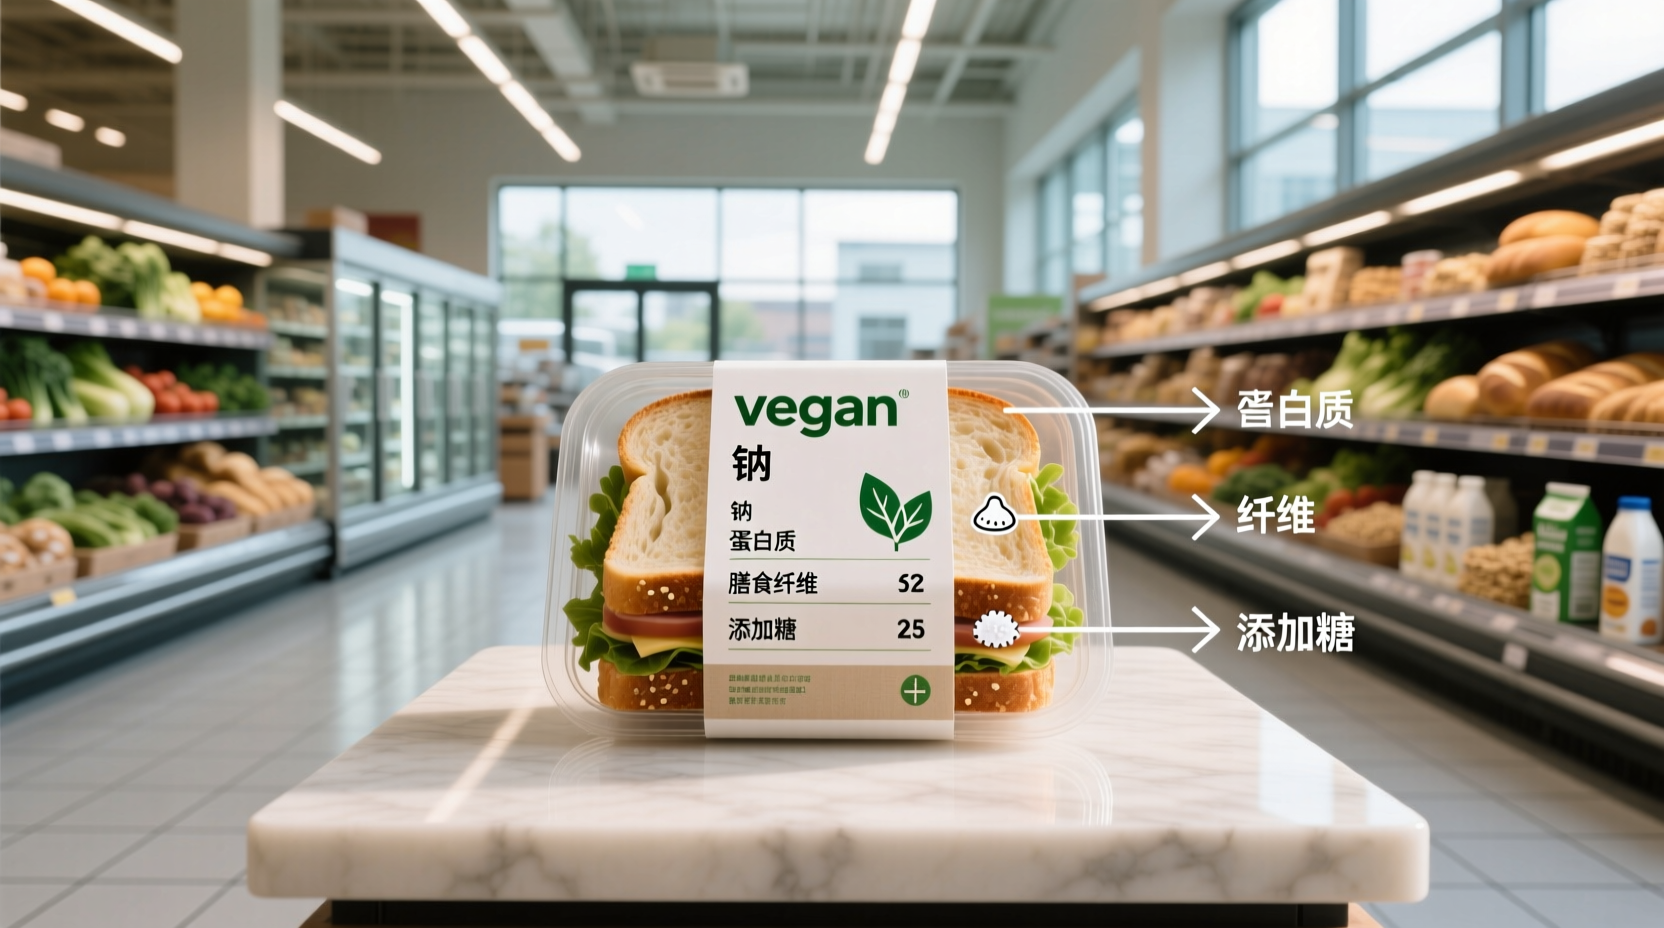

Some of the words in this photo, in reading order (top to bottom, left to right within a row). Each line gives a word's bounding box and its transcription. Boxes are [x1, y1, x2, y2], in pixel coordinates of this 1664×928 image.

[734, 394, 898, 438] vegan
[732, 444, 771, 482] 钠
[731, 500, 752, 522] 钠
[729, 529, 796, 552] 蛋白质
[728, 571, 818, 595] 膳食纤维
[898, 573, 925, 593] 52
[728, 617, 797, 642] 添加糖
[897, 618, 926, 640] 25
